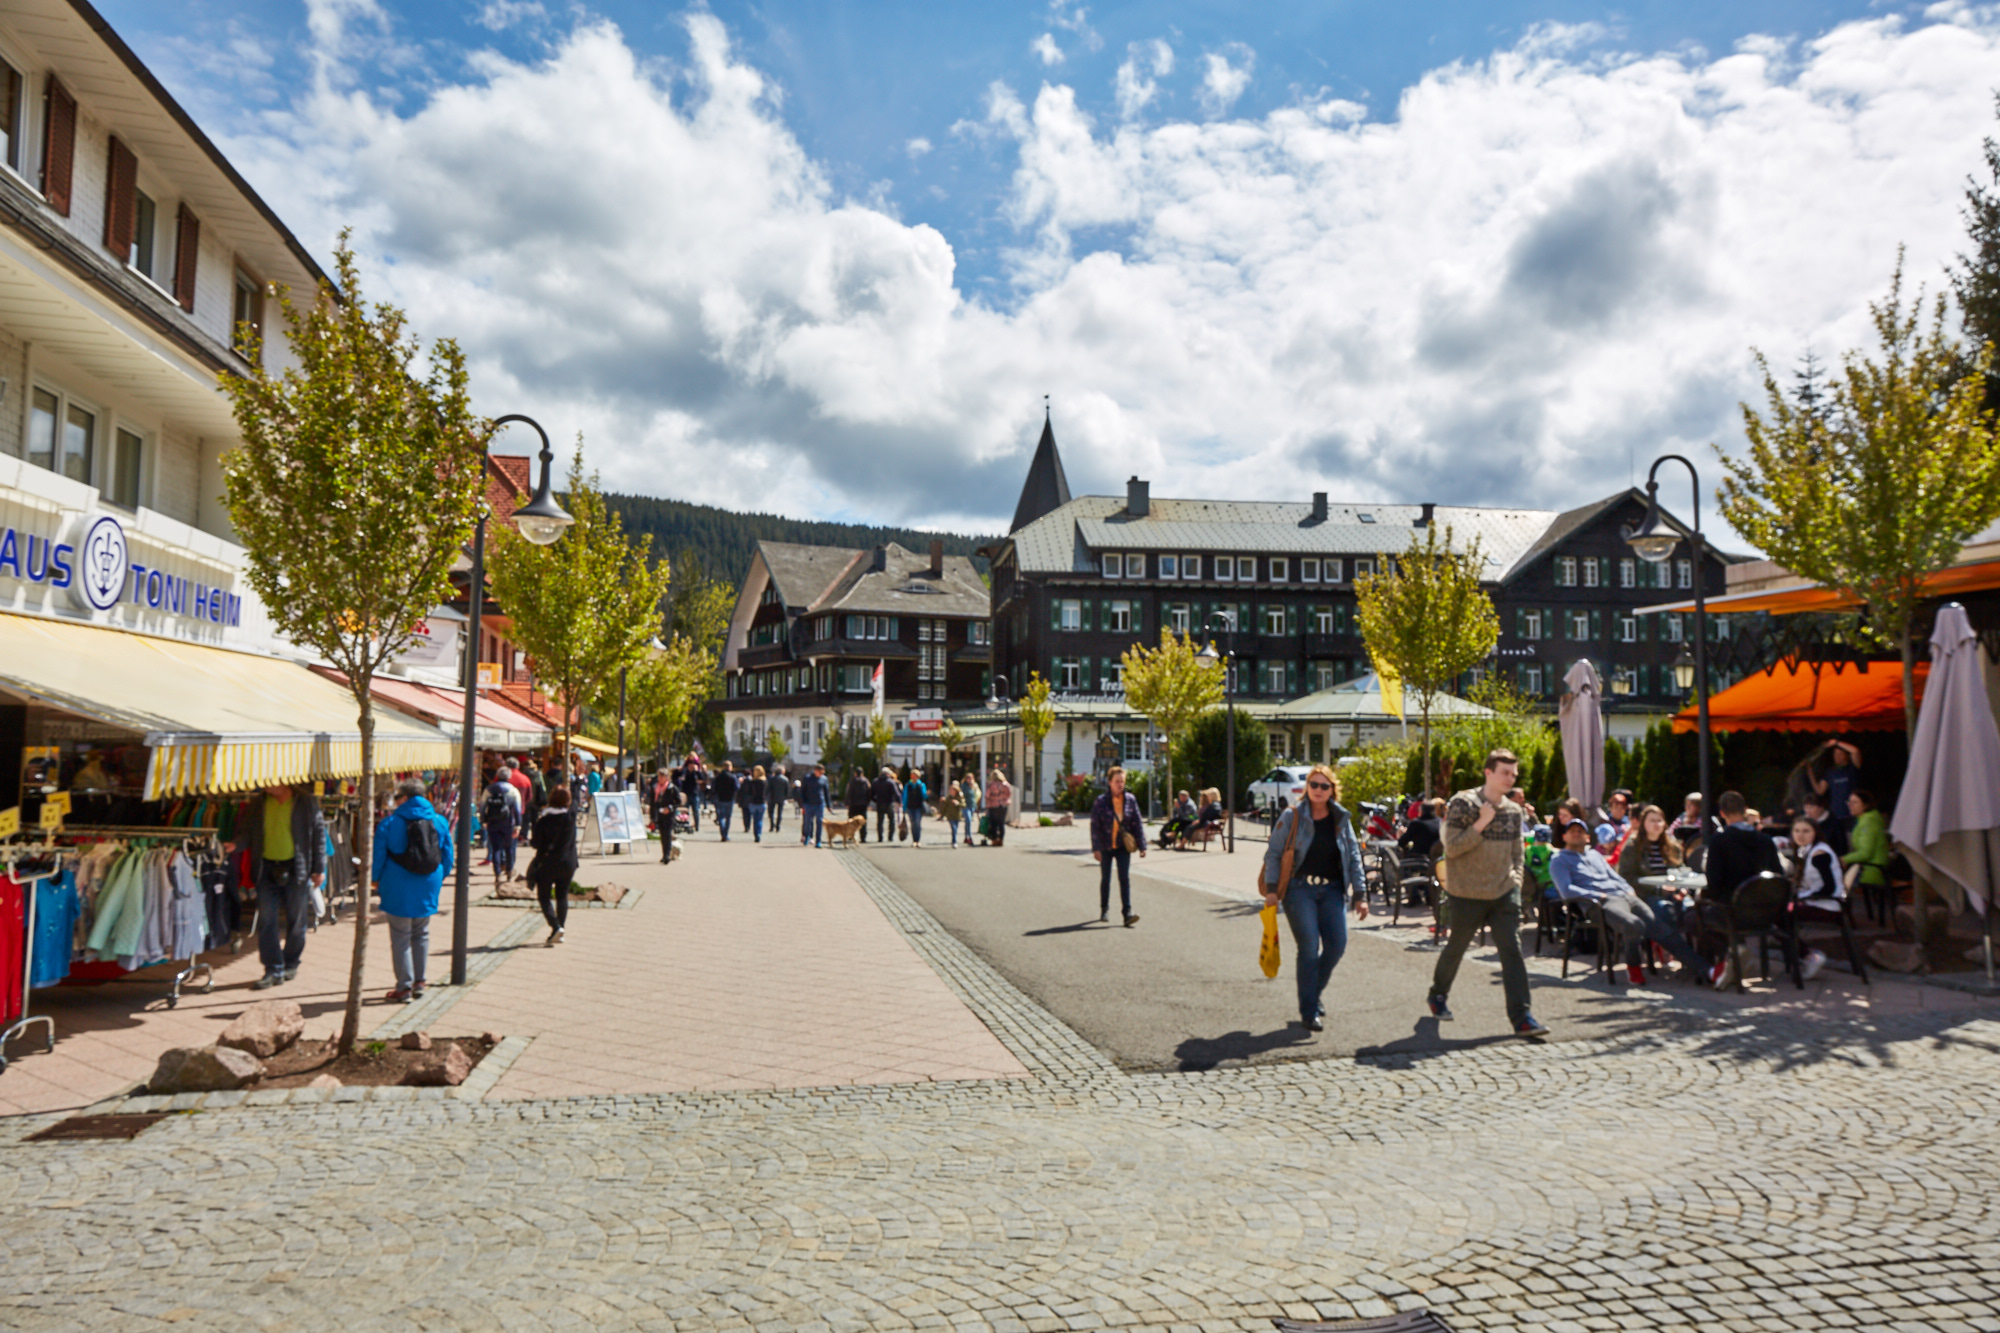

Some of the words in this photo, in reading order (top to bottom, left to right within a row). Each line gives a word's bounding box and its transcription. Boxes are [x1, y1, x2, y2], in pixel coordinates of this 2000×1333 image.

[0, 529, 74, 588] AUS
[131, 564, 187, 614] TONI
[195, 584, 241, 627] HEIM
